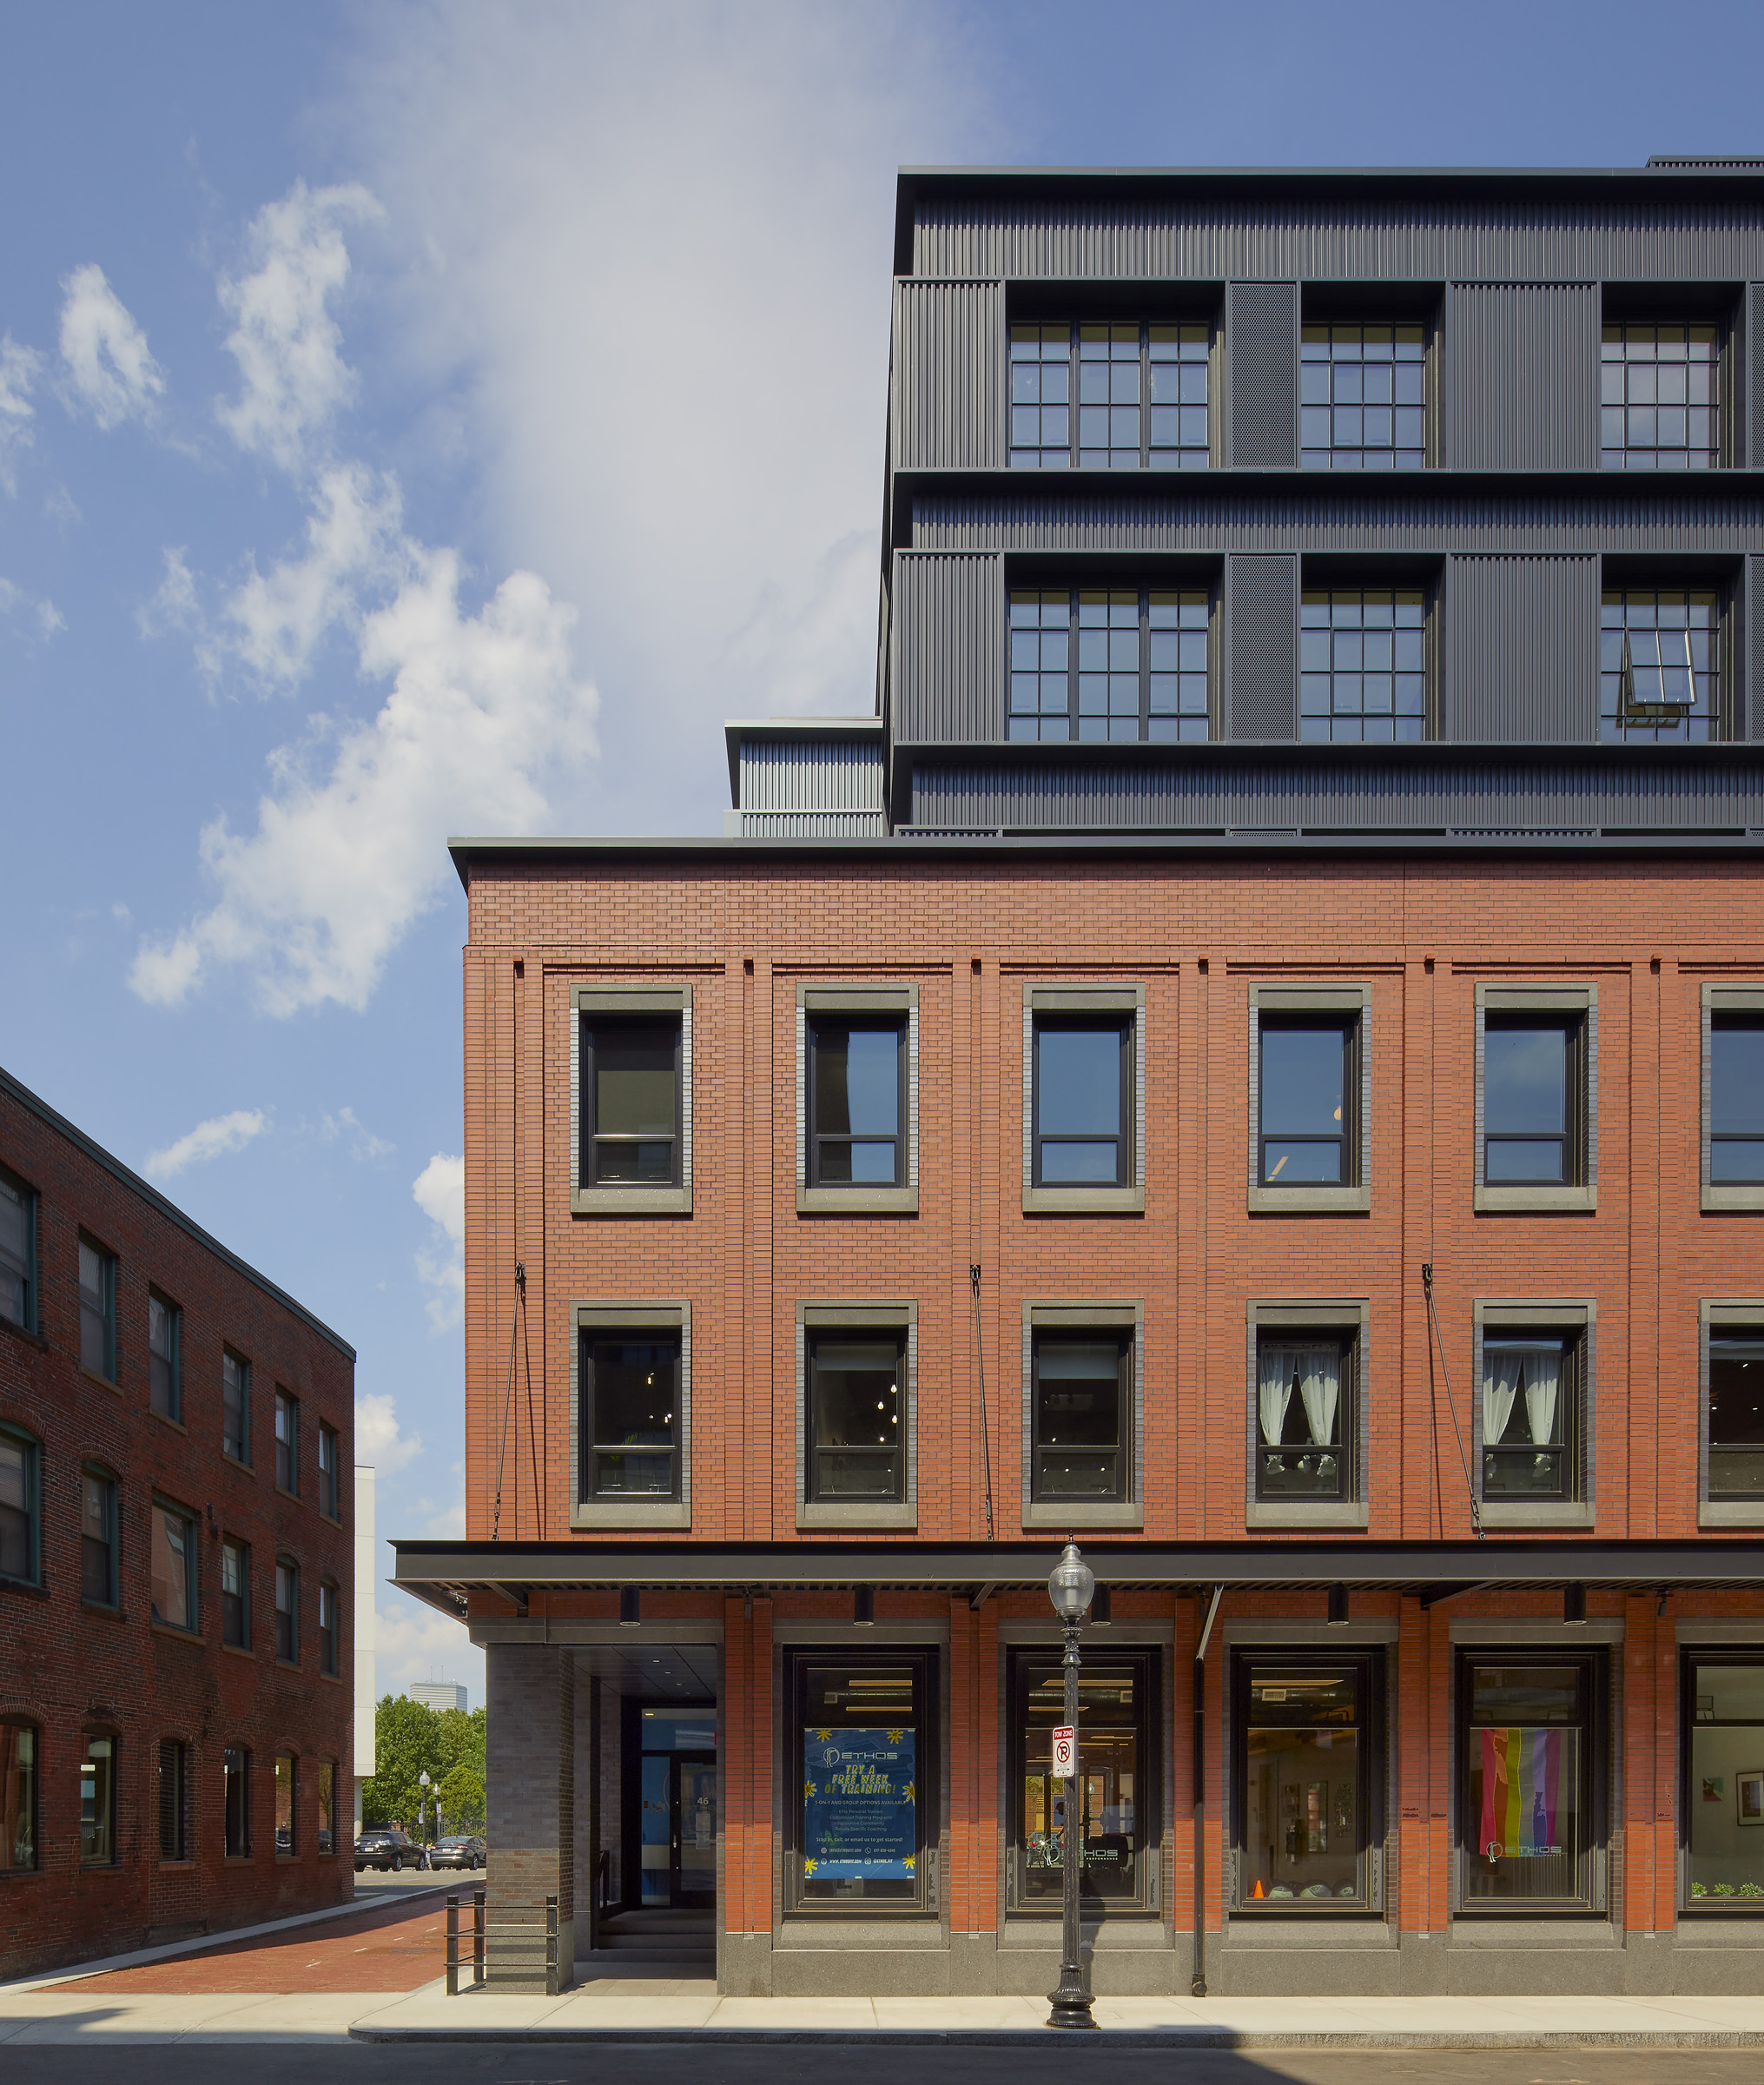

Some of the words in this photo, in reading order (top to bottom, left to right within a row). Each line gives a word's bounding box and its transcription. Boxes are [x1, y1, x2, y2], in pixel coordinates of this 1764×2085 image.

[846, 1765, 865, 1774] TRY
[869, 1765, 875, 1774] A
[832, 1775, 857, 1784] FREE
[861, 1775, 889, 1784] WEEK
[825, 1784, 837, 1794] OF
[842, 1784, 896, 1794] TRAINING!
[697, 1797, 709, 1805] 46
